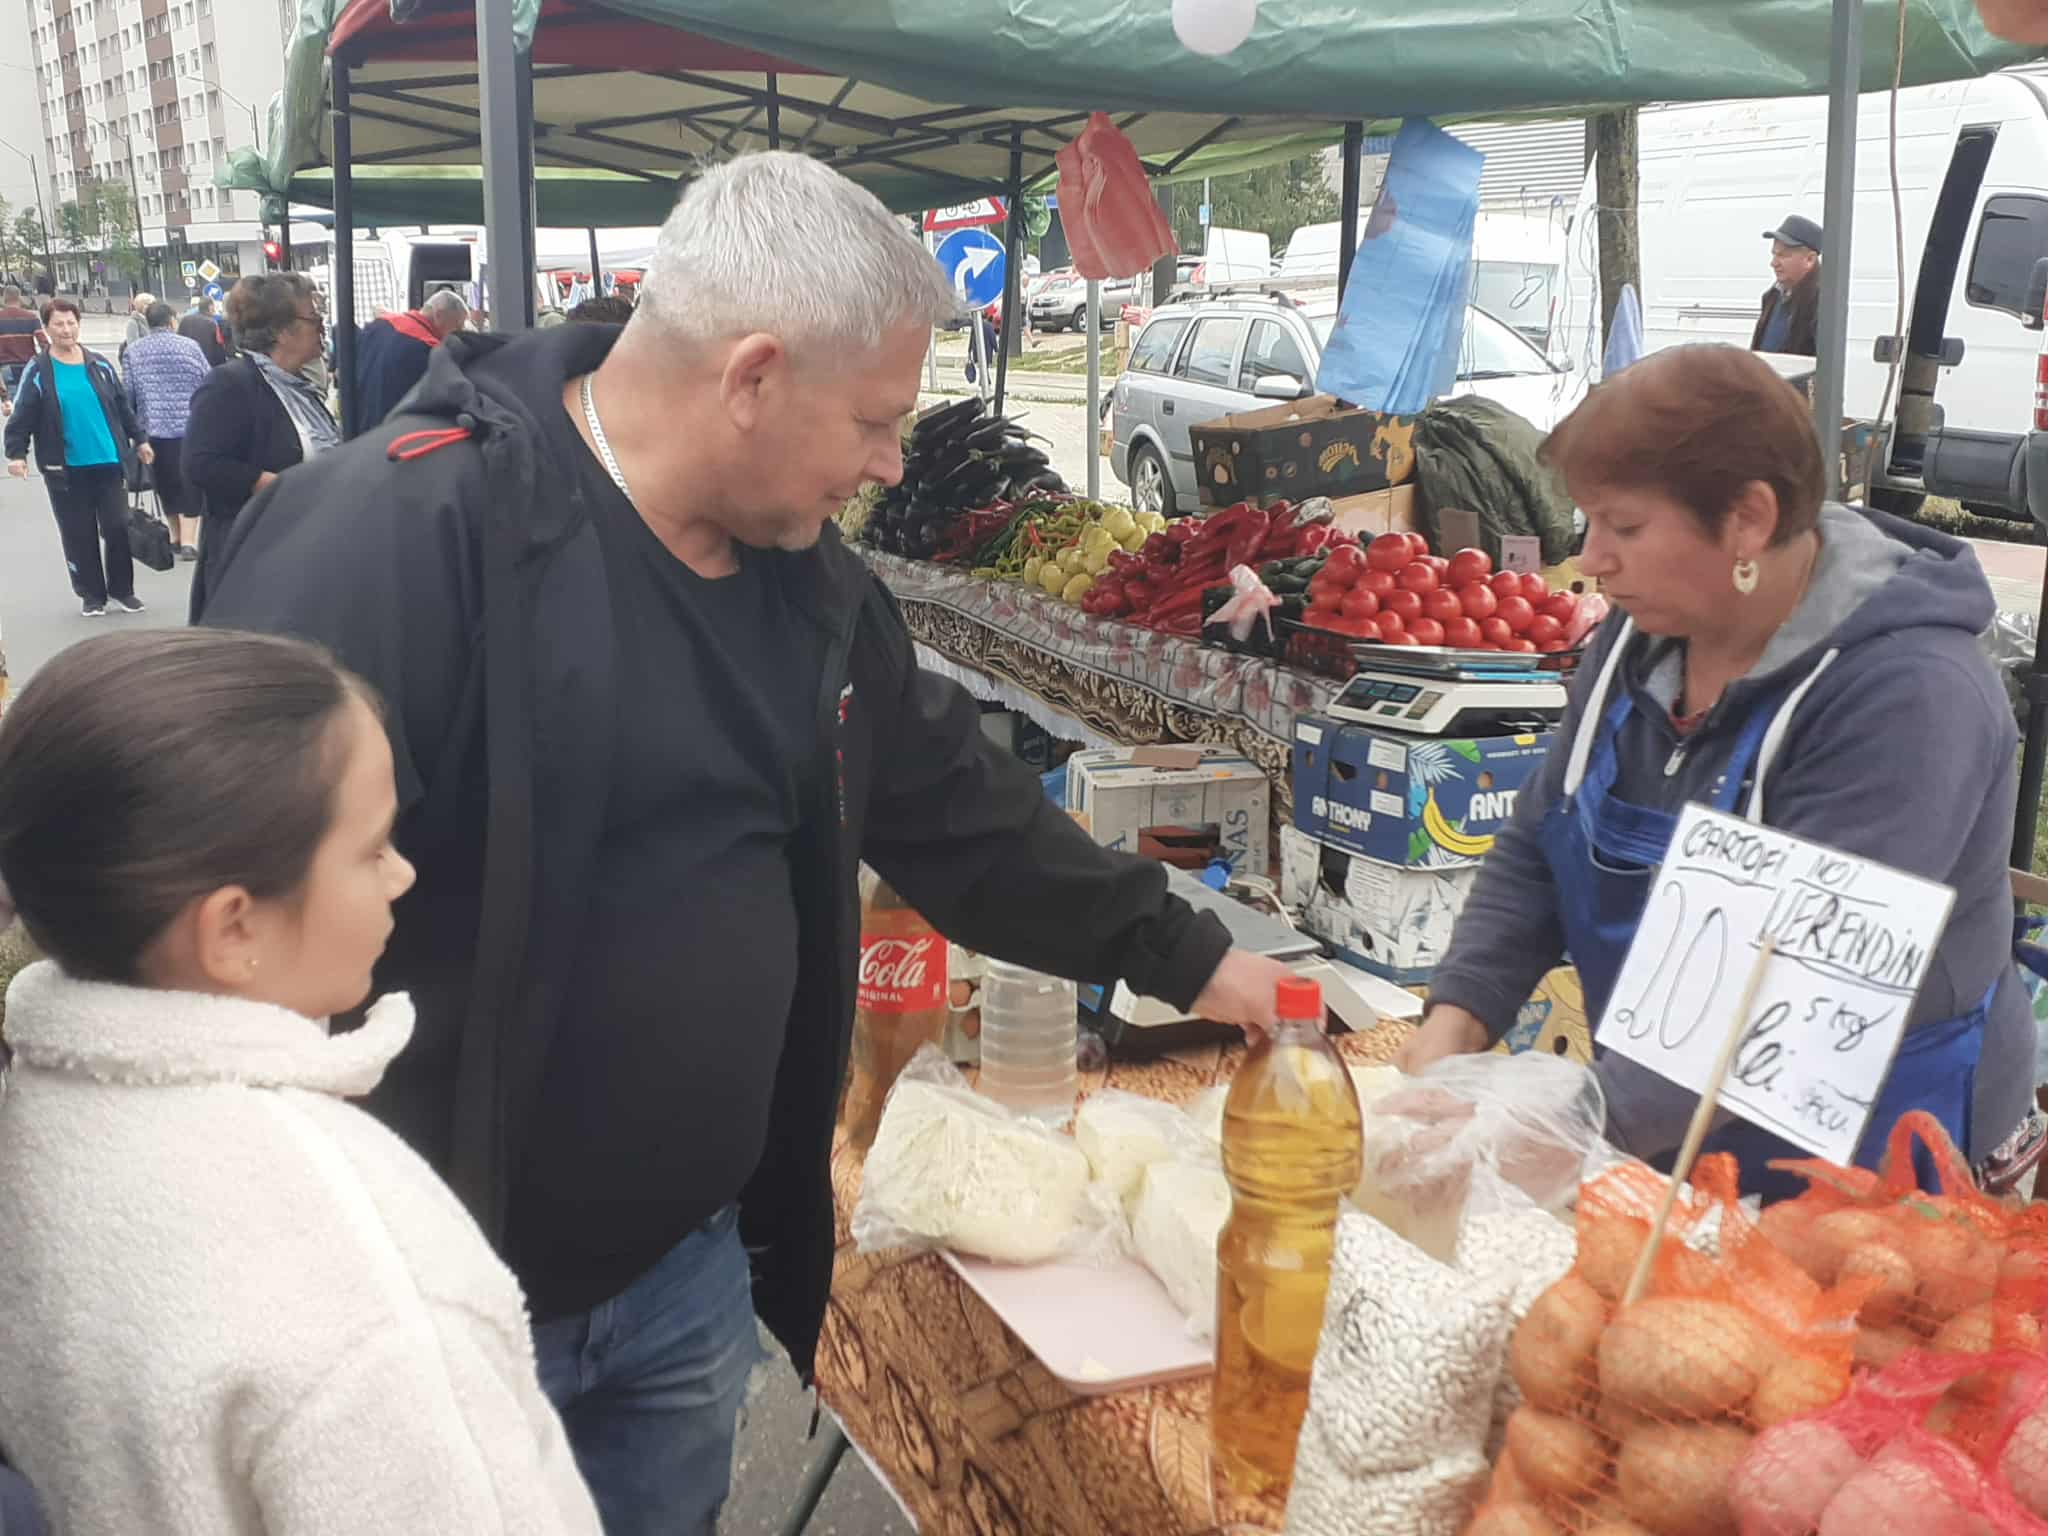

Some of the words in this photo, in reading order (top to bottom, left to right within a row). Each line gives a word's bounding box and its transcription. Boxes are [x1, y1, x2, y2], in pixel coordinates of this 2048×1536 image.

[1312, 795, 1372, 832] ANTHONY
[1615, 880, 1728, 1049] 20
[1803, 996, 1833, 1023] 5
